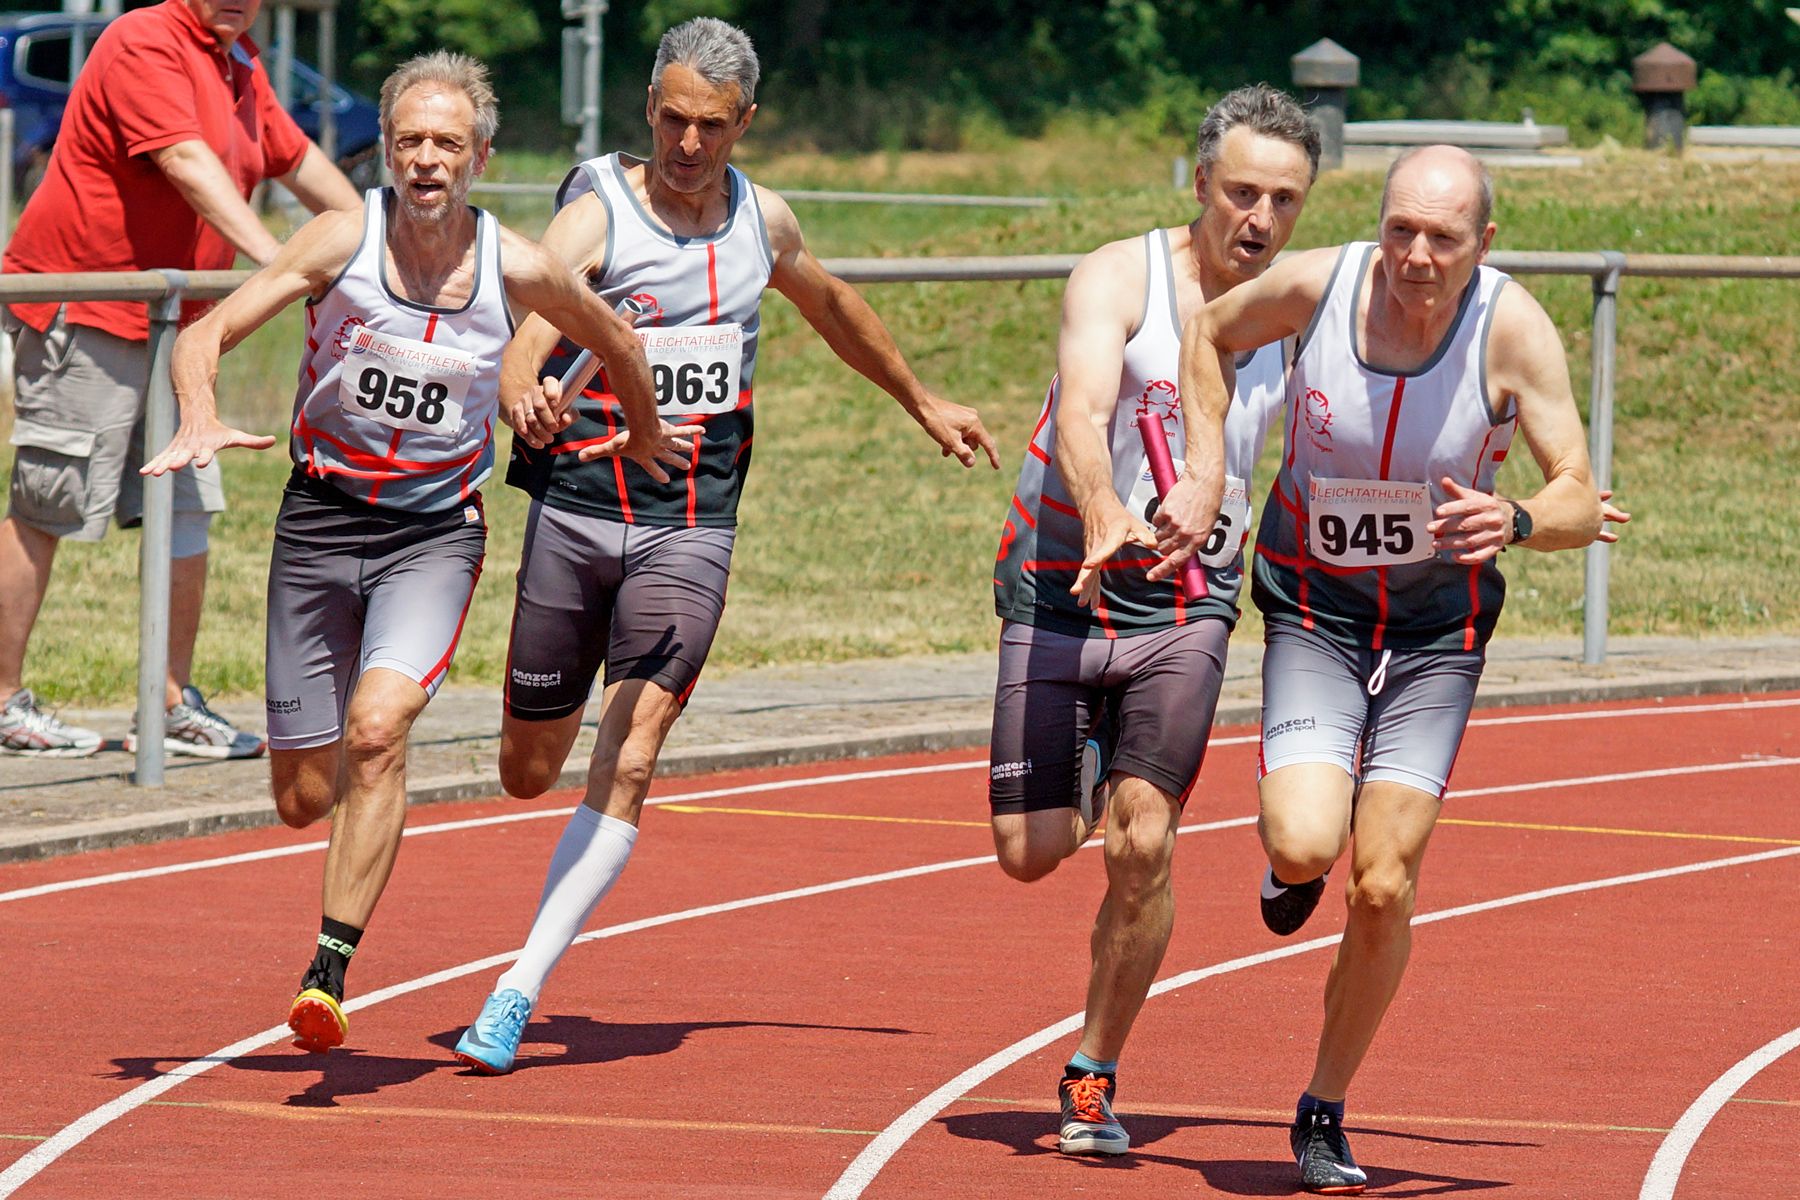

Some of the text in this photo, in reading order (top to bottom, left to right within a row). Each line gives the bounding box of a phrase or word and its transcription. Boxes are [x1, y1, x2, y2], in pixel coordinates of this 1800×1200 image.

[649, 332, 739, 348] LEICHTATHLETIK
[370, 340, 471, 372] LEICHTATHLETIK
[650, 361, 729, 407] 963
[356, 367, 448, 425] 958
[1317, 487, 1423, 500] LEICHTATHLETIK
[1318, 513, 1414, 557] 945
[512, 668, 561, 682] panzeri
[541, 679, 561, 688] sport
[1294, 725, 1316, 733] sport
[1012, 769, 1032, 778] sport
